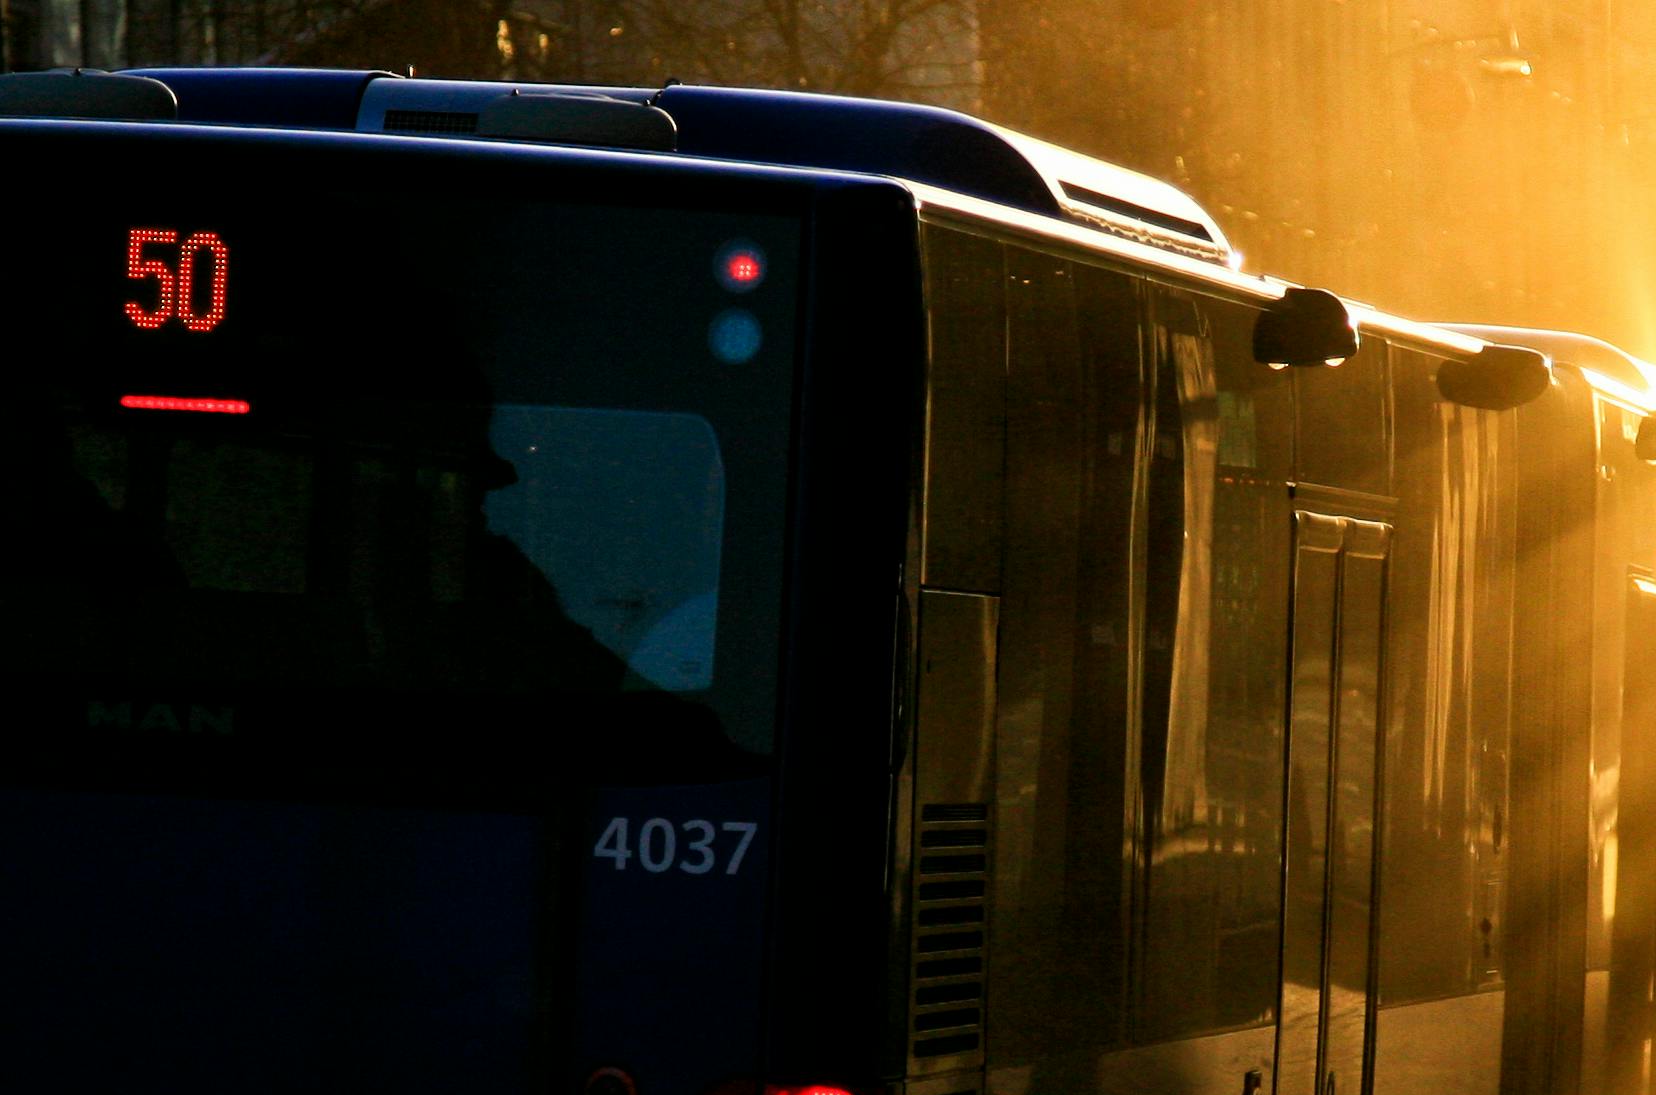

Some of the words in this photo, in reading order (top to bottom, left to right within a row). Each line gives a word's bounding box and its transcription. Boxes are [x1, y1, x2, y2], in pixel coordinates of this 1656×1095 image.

[122, 226, 229, 333] 50
[87, 700, 235, 735] MAN
[593, 816, 758, 876] 4037
